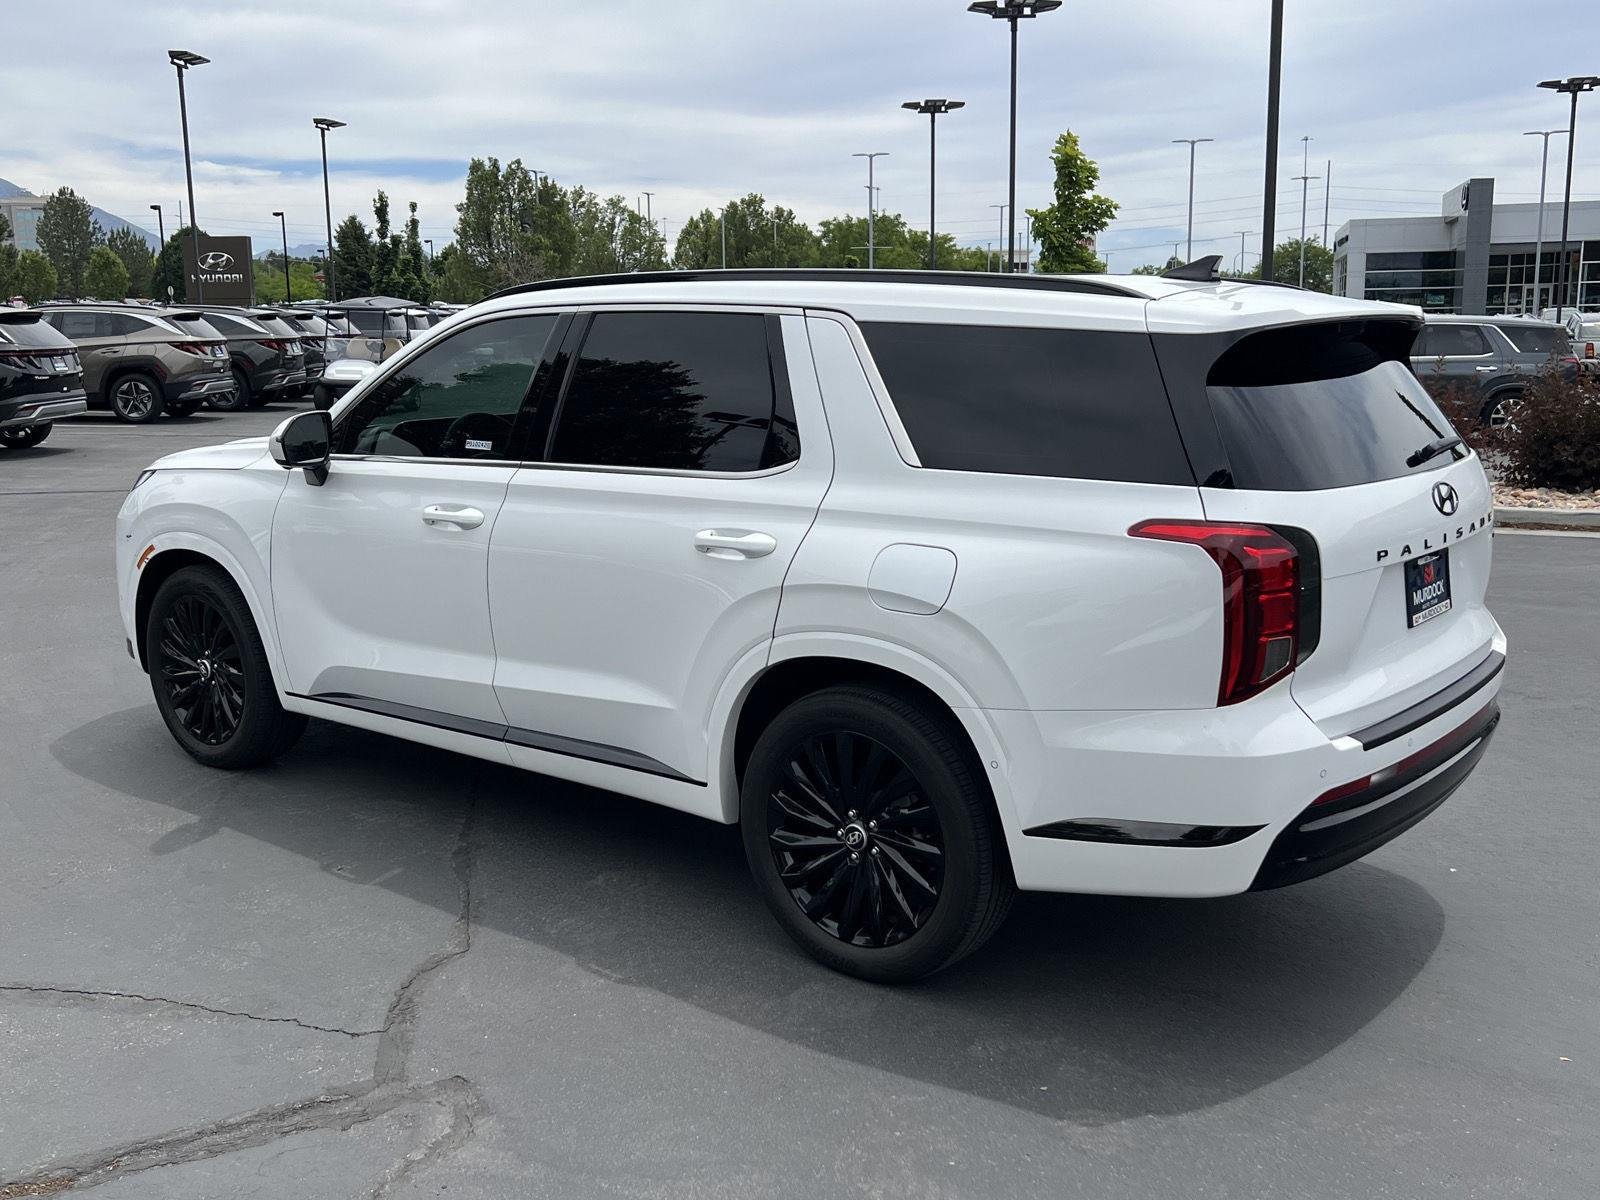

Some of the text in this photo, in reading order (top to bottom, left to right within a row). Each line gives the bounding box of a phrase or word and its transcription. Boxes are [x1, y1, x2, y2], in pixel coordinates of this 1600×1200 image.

[191, 274, 242, 283] HYUNDAI
[1377, 512, 1492, 561] PALISADE
[1413, 579, 1444, 605] MURDOCK
